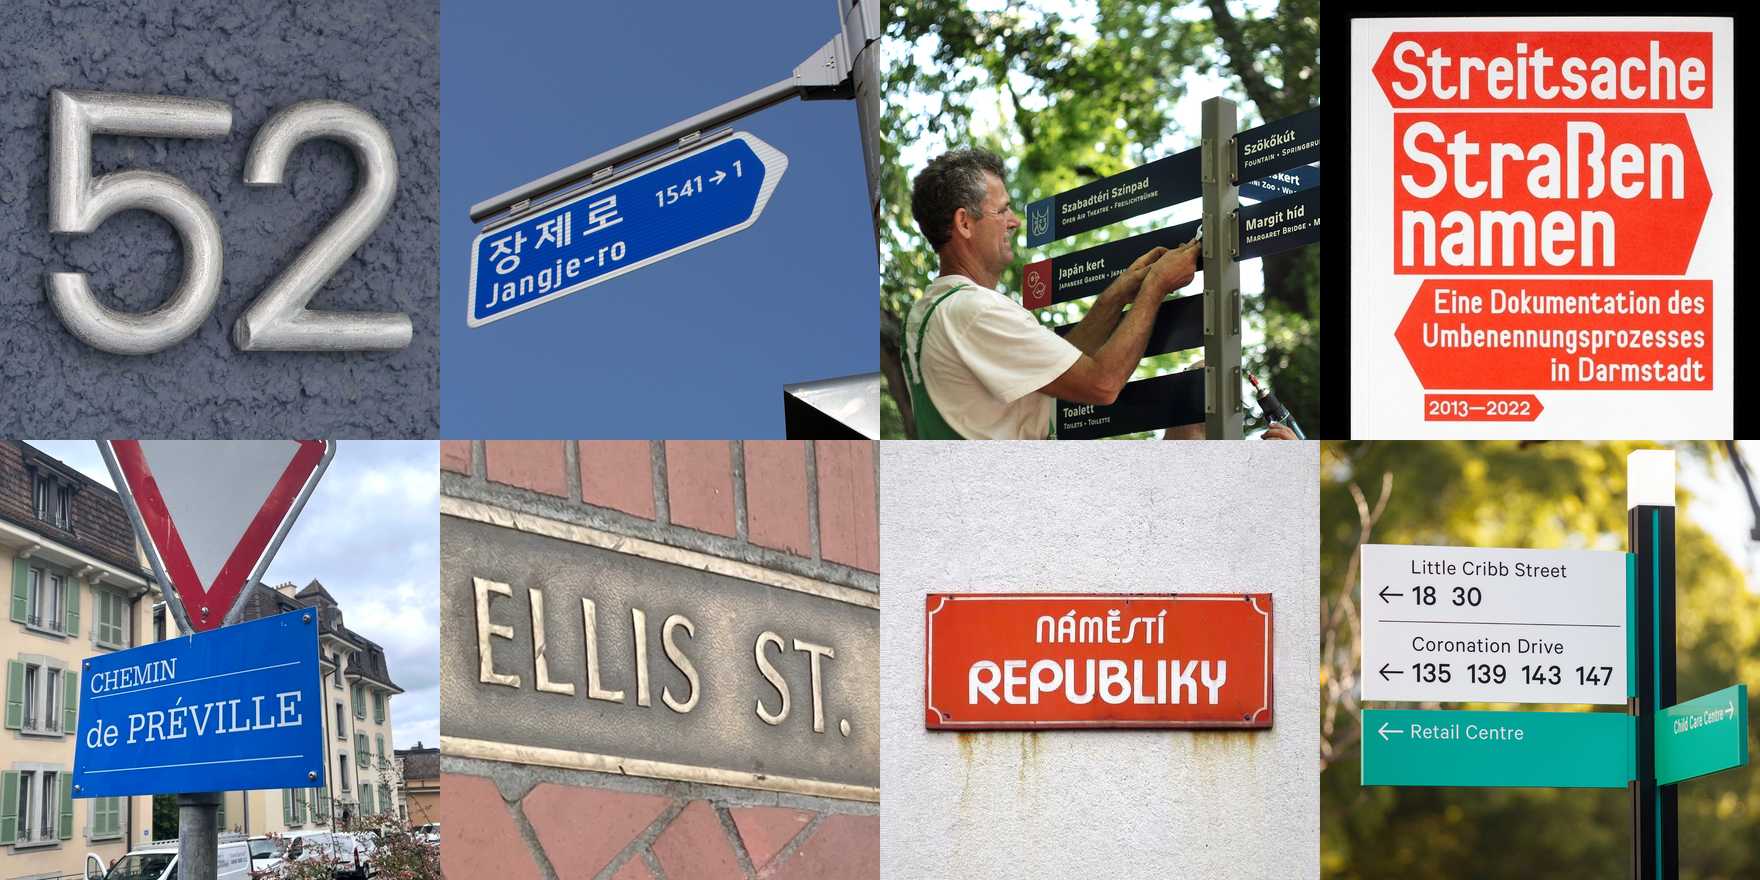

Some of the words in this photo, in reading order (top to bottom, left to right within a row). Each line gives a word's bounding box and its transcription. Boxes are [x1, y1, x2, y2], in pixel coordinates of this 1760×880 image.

[1391, 40, 1706, 100] Streitsache
[1244, 130, 1296, 156] Szökőkút
[1400, 120, 1685, 200] Straßen
[655, 176, 703, 208] 1541
[732, 159, 744, 179] 1
[1062, 189, 1109, 214] Szabadtéri
[1111, 177, 1149, 198] Színpad
[45, 87, 413, 355] 52
[489, 194, 624, 275] 장제로
[1246, 211, 1284, 232] Margit
[1286, 204, 1305, 220] híd
[1401, 209, 1616, 267] namen
[486, 241, 626, 308] Jangje-ro
[1058, 263, 1084, 280] Japán
[1086, 258, 1105, 271] kert
[1434, 289, 1482, 314] Eine
[1490, 288, 1661, 315] Dokumentation
[1667, 290, 1705, 315] des
[1422, 322, 1705, 354] Umbenennungsprozesses
[1551, 358, 1570, 382] in
[1578, 357, 1705, 383] Darmstadt
[1063, 404, 1095, 418] Toalett
[1411, 559, 1457, 576] Little
[1462, 560, 1510, 577] Cribb
[1514, 562, 1568, 579] Street
[1411, 585, 1437, 606] 18
[1452, 586, 1482, 607] 30
[1036, 608, 1168, 645] NÁMĚSTÍ
[473, 576, 700, 714] ELLIS
[755, 631, 852, 738] ST.
[1412, 636, 1511, 655] Coronation
[1518, 638, 1564, 656] Drive
[90, 657, 178, 694] CHEMIN
[968, 659, 1228, 706] REPUBLIKY
[1411, 663, 1452, 684] 135
[1467, 664, 1507, 685] 139
[1521, 664, 1562, 686] 143
[1576, 665, 1614, 687] 147
[86, 719, 119, 749] de
[126, 690, 303, 745] PRÉVILLE
[1411, 723, 1460, 741] Retail
[1466, 724, 1525, 742] Centre
[1673, 717, 1689, 735] Child
[1689, 715, 1703, 730] Care
[1704, 708, 1724, 726] Centre
